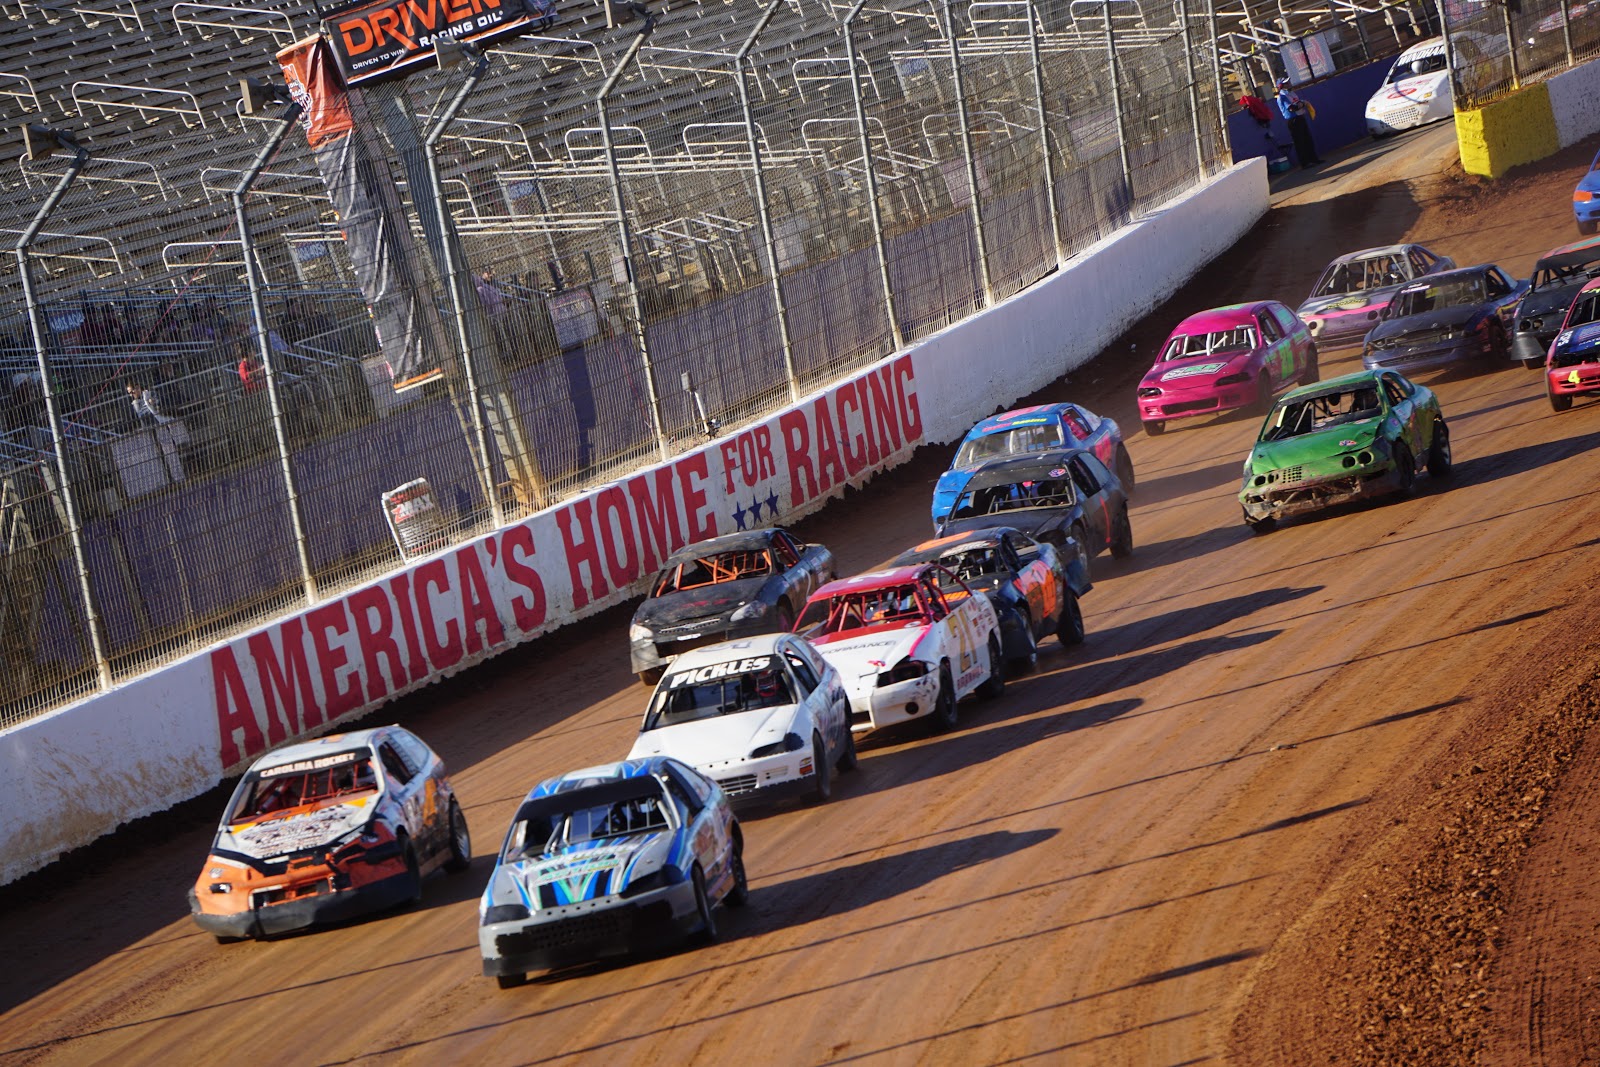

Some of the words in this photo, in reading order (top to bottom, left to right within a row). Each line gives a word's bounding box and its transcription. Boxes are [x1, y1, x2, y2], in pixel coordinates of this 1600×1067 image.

[352, 56, 379, 70] DRIVEN
[379, 52, 391, 60] TO
[390, 48, 405, 58] WIN
[1568, 369, 1580, 384] 4
[210, 524, 547, 770] AMERICA'S
[555, 451, 718, 609] HOME
[719, 424, 777, 495] FOR
[779, 354, 922, 507] RACING
[669, 656, 771, 689] PICKLES
[260, 761, 314, 777] CAROLINA
[315, 753, 355, 768] ROCKET
